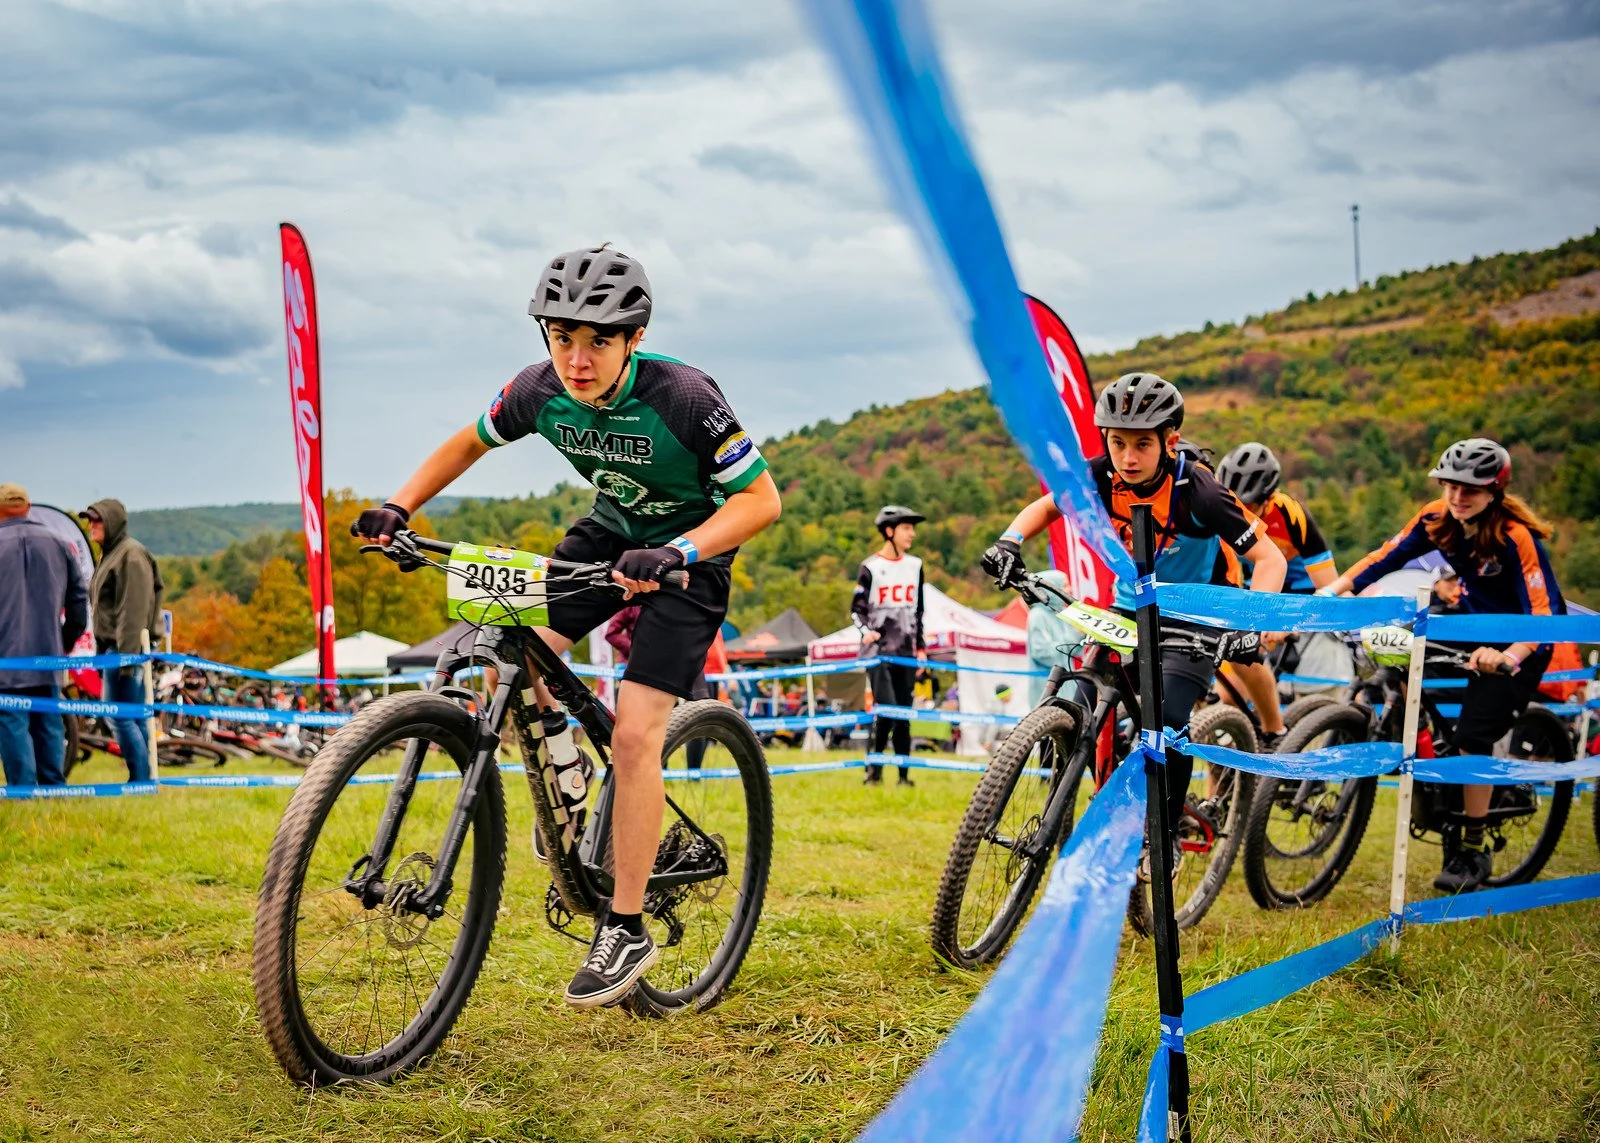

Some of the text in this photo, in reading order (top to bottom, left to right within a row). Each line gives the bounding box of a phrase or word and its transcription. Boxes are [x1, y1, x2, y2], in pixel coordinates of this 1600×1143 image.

[554, 421, 654, 458] TVMTB
[565, 446, 642, 466] RACING TEAM
[465, 563, 527, 595] 2035
[878, 584, 915, 605] FCC
[1078, 613, 1130, 639] 2120
[1371, 632, 1408, 647] 2022
[57, 701, 119, 715] SHIMANO
